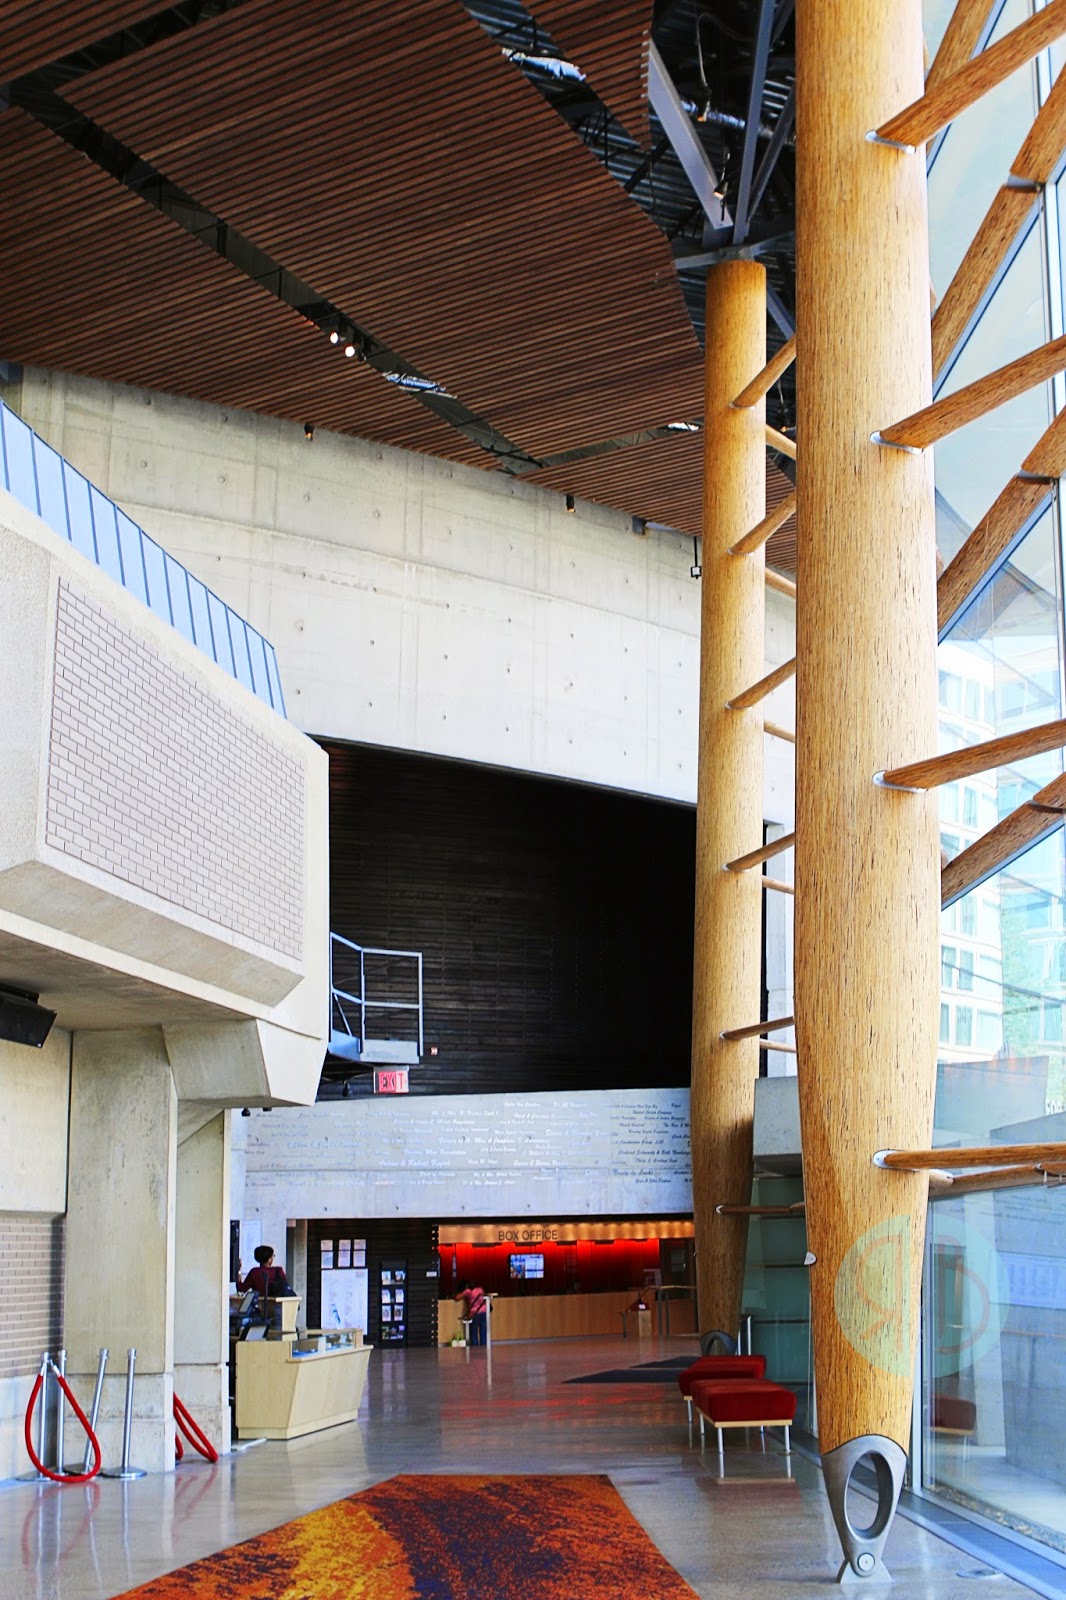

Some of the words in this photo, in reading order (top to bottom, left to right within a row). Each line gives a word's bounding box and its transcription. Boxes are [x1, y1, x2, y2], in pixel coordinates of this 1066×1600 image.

[379, 1072, 404, 1092] EXIT
[498, 1230, 519, 1241] BOX
[522, 1229, 558, 1241] OFFICE
